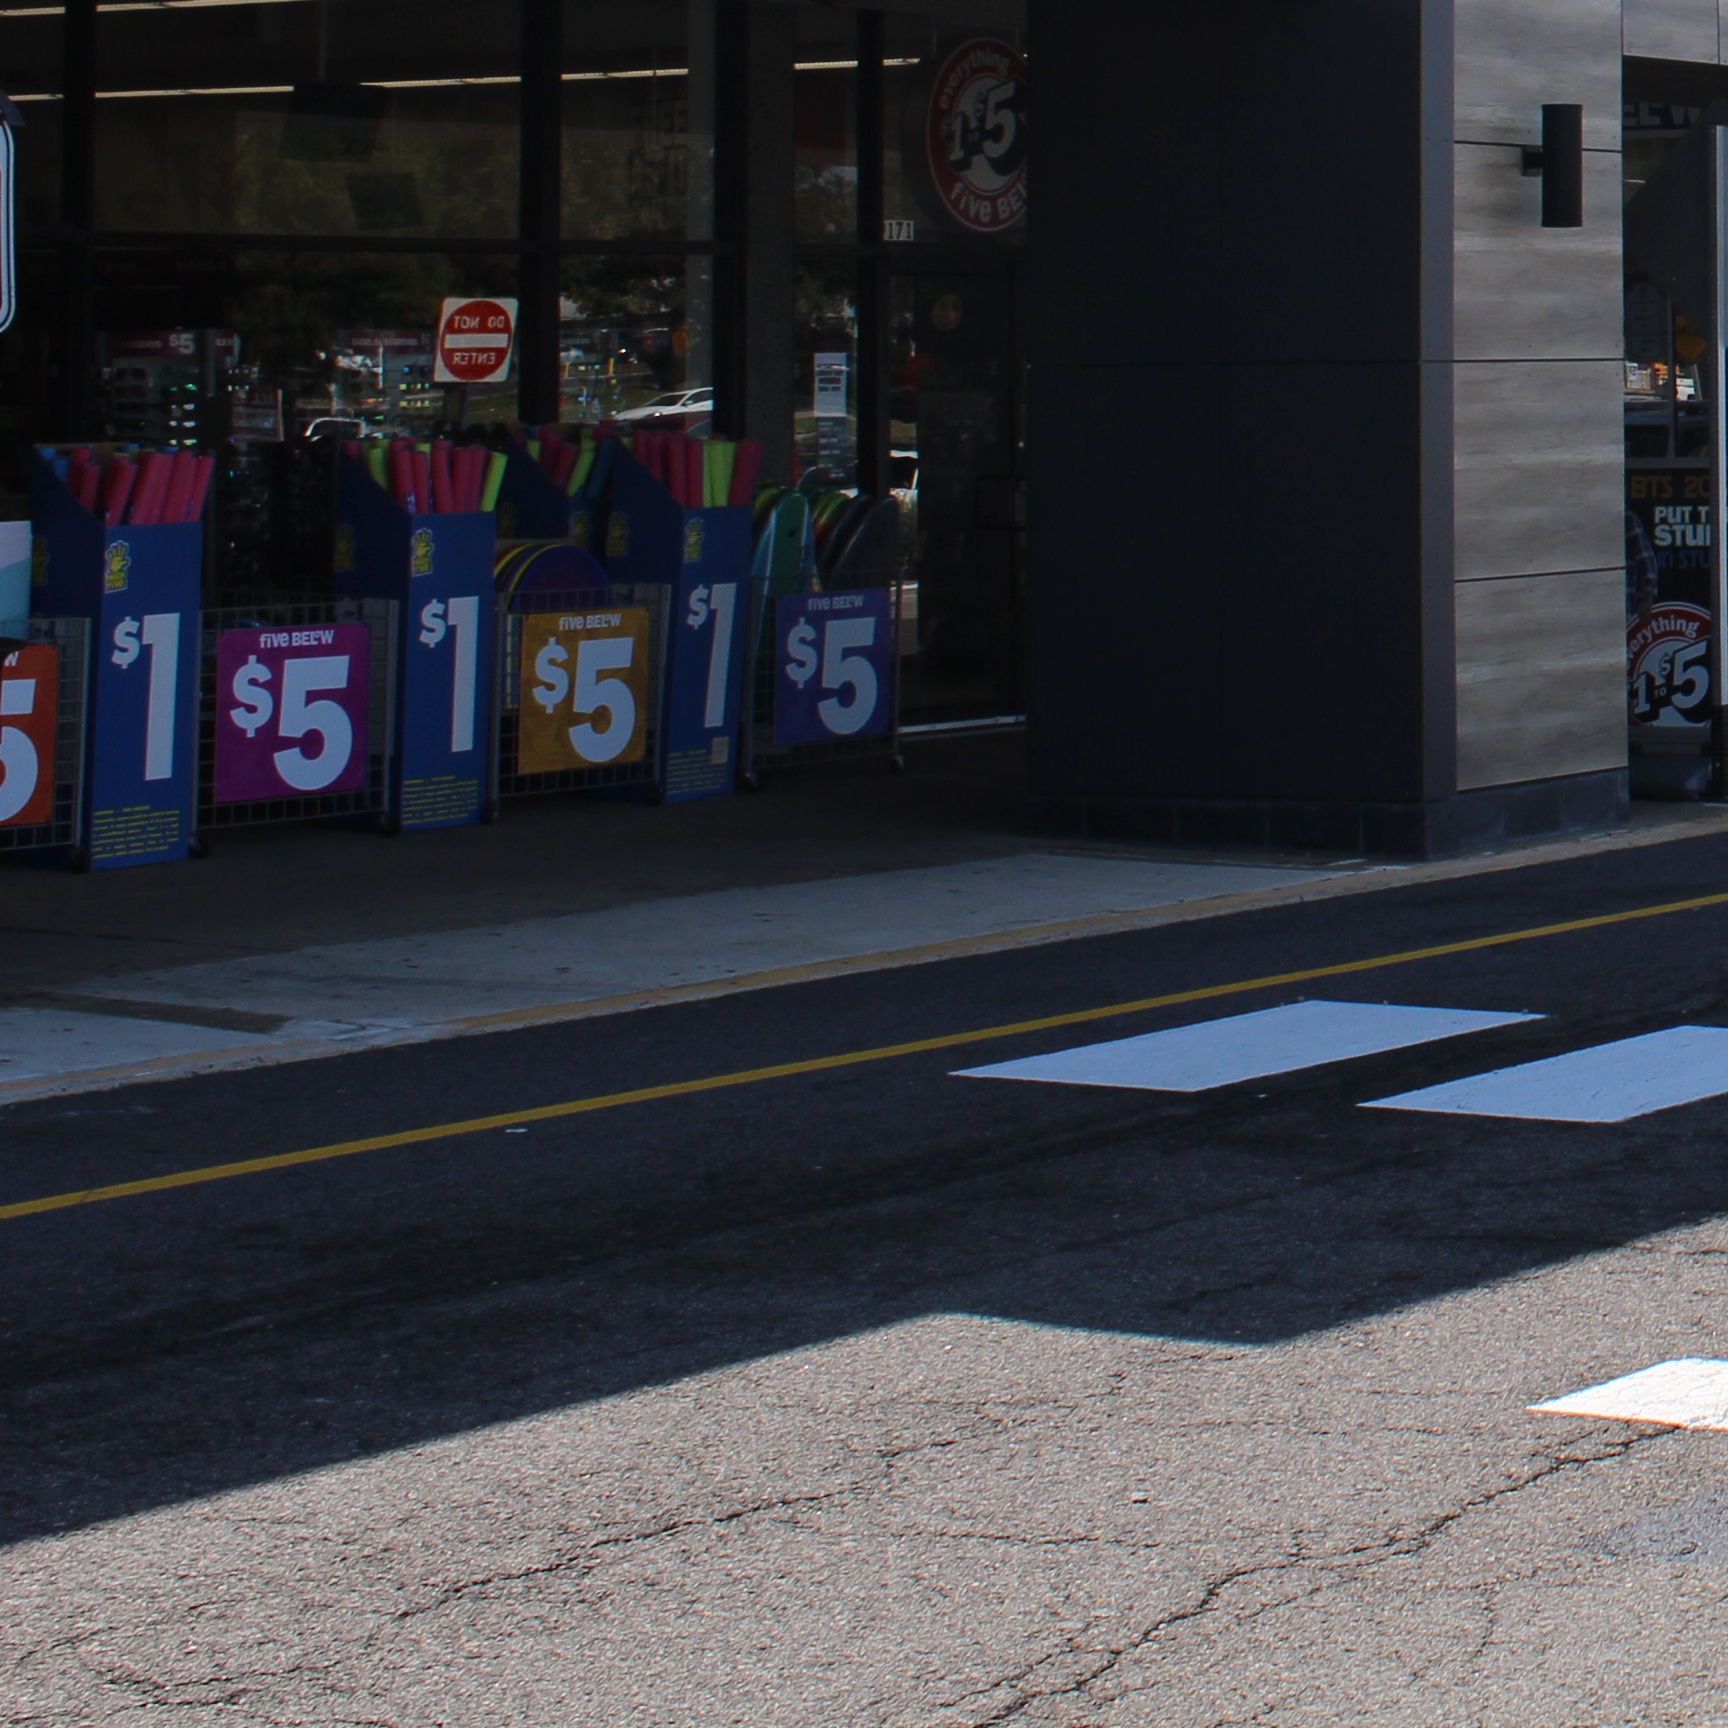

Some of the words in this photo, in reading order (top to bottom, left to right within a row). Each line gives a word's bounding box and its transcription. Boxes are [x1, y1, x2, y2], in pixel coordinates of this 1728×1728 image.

[1654, 505, 1692, 524] PUT
[259, 630, 290, 650] five
[559, 613, 583, 632] five
[686, 582, 738, 729] $1
[807, 595, 830, 611] five
[110, 612, 181, 781] $1
[230, 655, 354, 791] $5
[419, 596, 480, 753] $1
[532, 637, 636, 764] $5
[785, 616, 878, 736] $5
